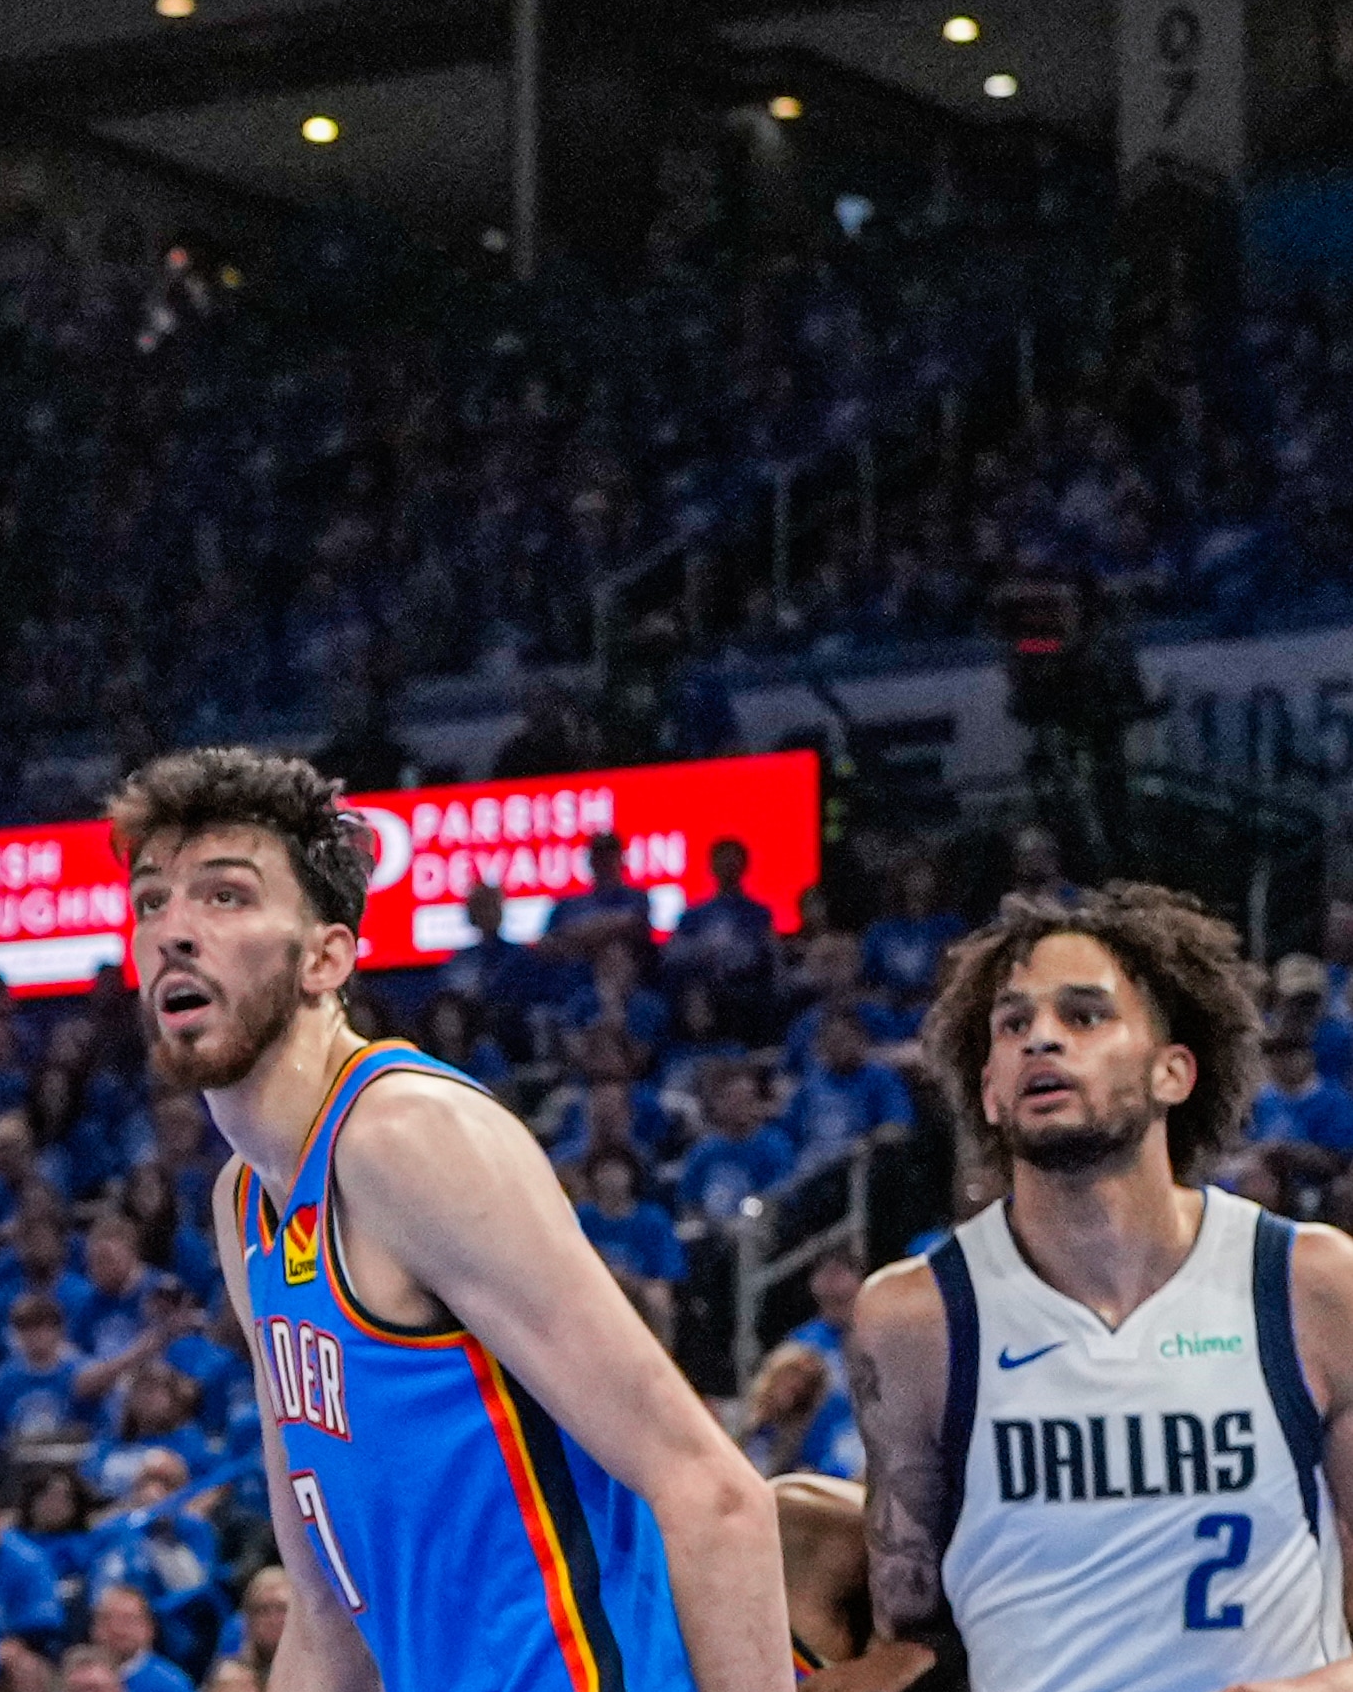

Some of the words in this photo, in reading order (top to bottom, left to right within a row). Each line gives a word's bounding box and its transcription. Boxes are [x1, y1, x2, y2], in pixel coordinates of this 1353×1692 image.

[412, 786, 614, 849] PARRISH
[1159, 1329, 1243, 1357] chime
[993, 1409, 1257, 1506] DALLAS
[1183, 1512, 1252, 1631] 2
